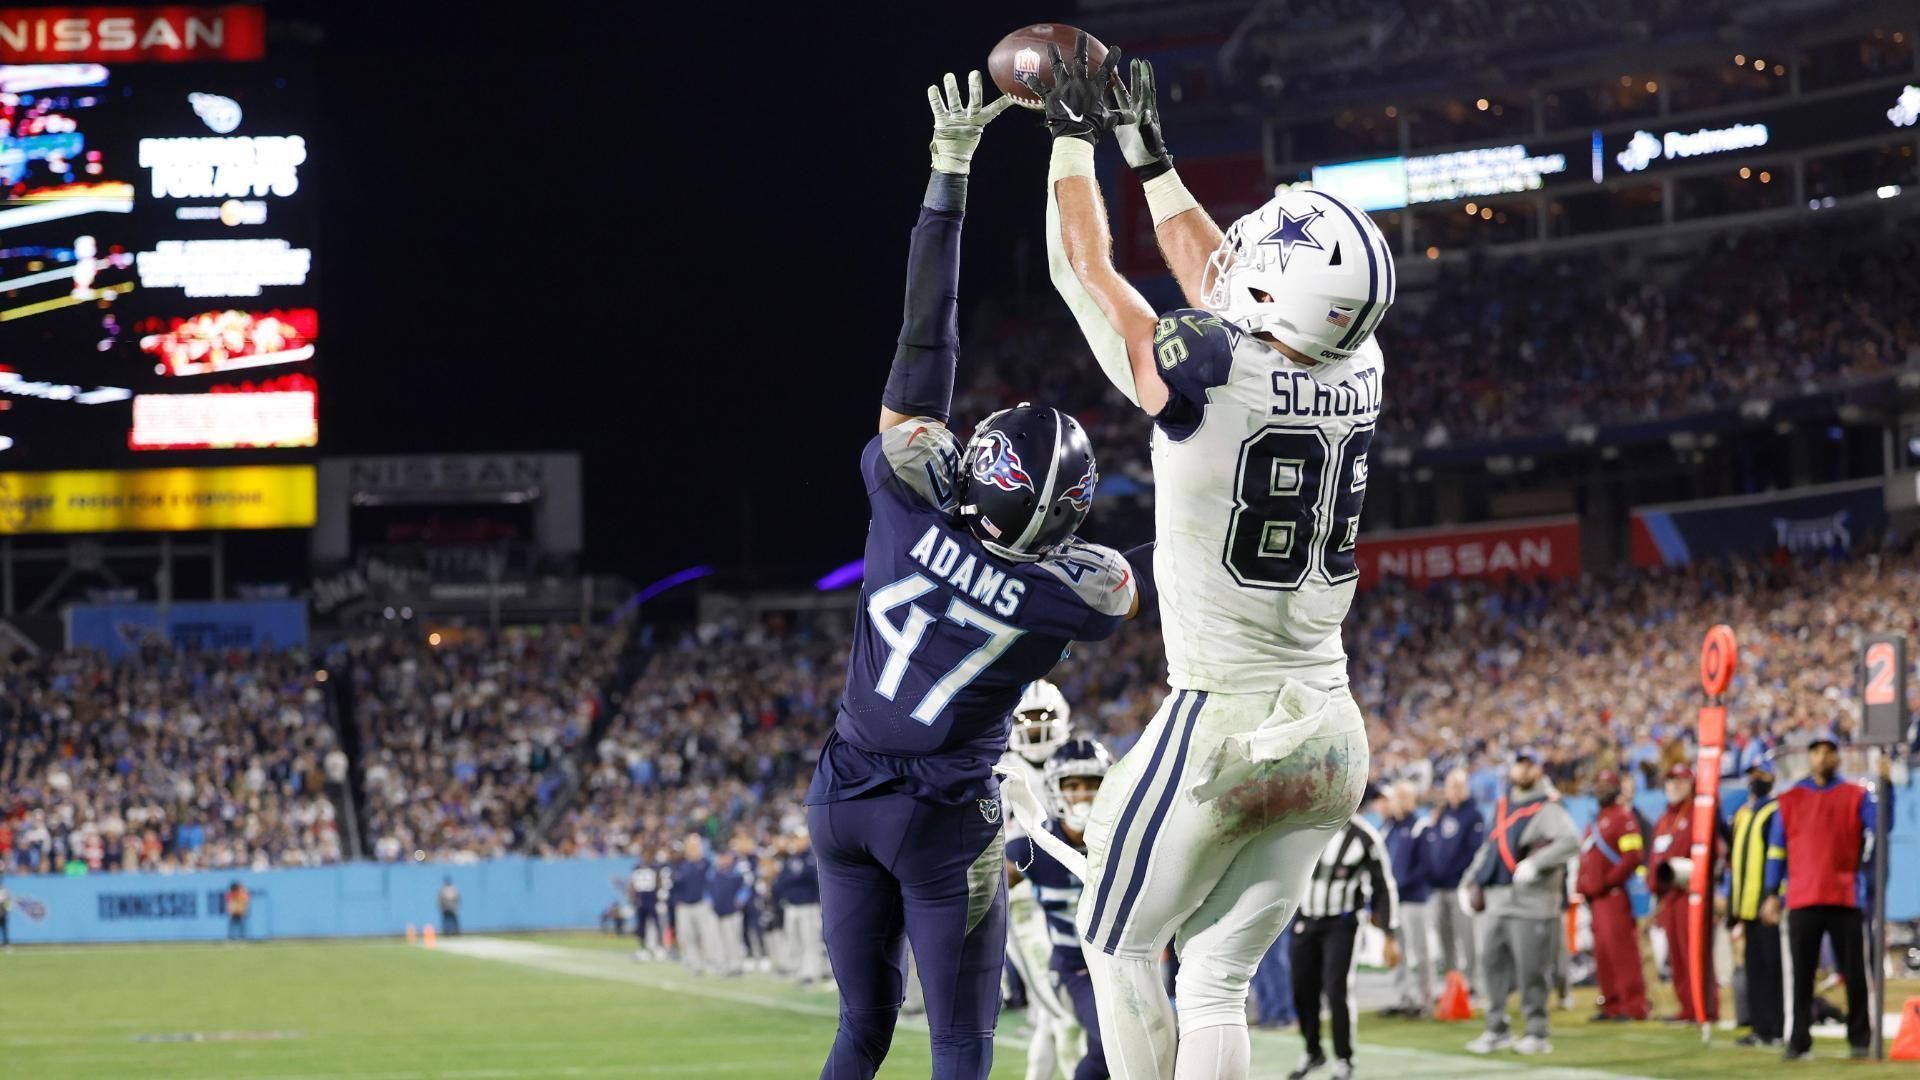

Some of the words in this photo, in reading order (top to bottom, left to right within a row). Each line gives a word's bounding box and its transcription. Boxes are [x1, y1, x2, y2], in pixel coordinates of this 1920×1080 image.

[0, 17, 225, 50] NISSAN
[1153, 316, 1189, 370] 86
[1271, 367, 1380, 417] SCHULTZ
[1222, 419, 1375, 591] 86
[908, 525, 1026, 618] ADAMS
[1377, 537, 1552, 578] NISSAN
[868, 571, 1030, 726] 47
[1865, 643, 1895, 704] 2
